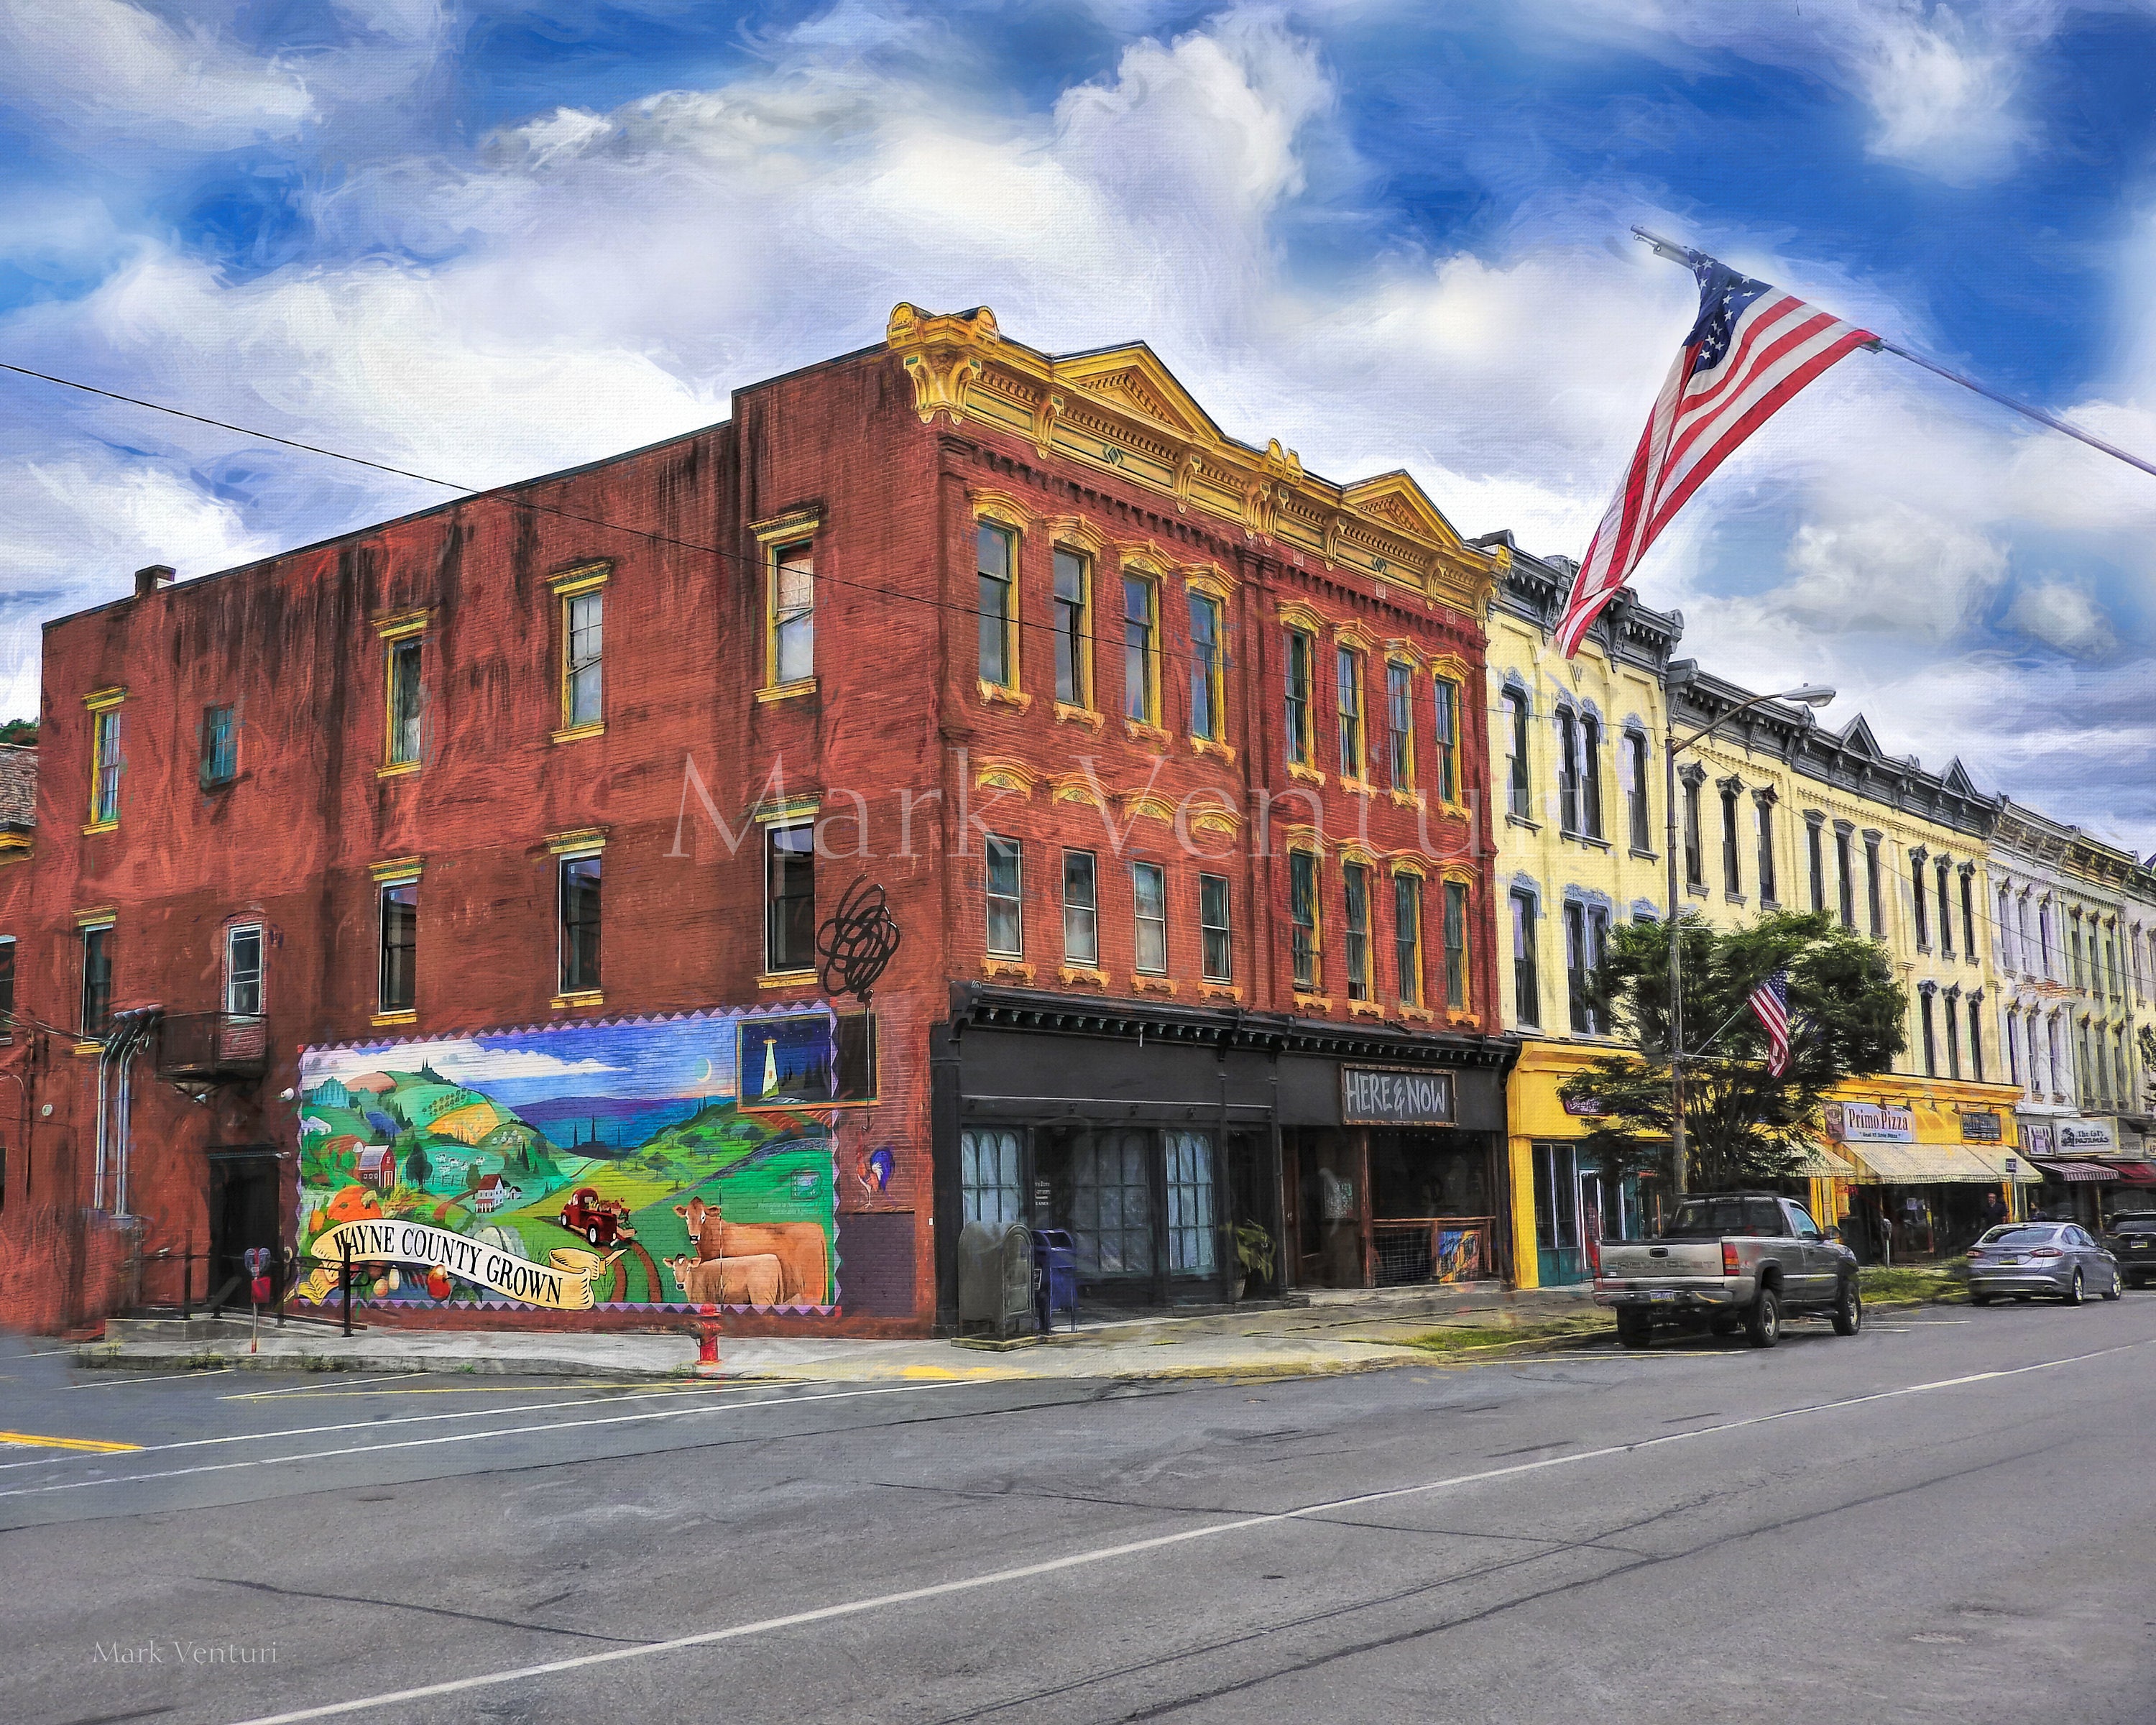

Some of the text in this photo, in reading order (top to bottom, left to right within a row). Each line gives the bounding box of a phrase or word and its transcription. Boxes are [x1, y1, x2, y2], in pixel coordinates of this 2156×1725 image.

[1345, 1070, 1392, 1113] HERE
[1406, 1077, 1445, 1113] NOW
[1848, 1108, 1908, 1131] Primo Pizza
[333, 1225, 563, 1305] WAYNE COUNTY GROWN
